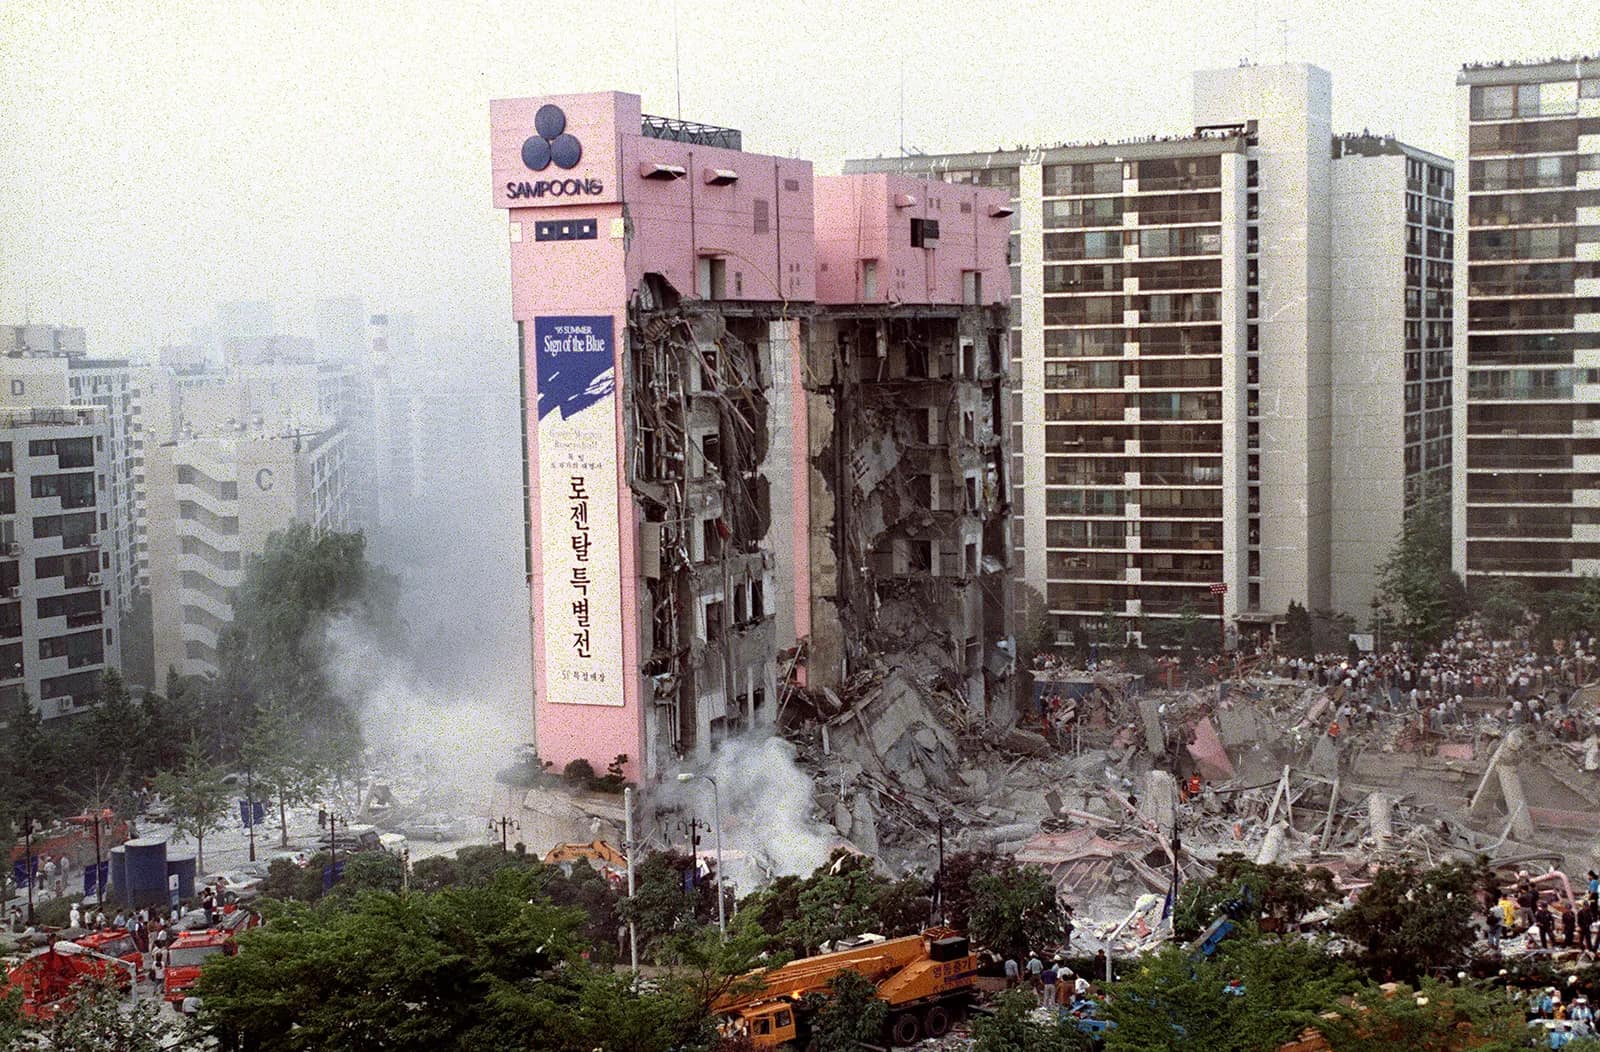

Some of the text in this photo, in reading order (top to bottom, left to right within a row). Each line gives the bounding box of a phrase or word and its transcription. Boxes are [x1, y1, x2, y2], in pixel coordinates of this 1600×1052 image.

[506, 178, 604, 199] SAMPOONG
[564, 325, 592, 335] SUMMER
[544, 335, 605, 357] Sign of the Blue
[11, 379, 25, 396] D
[255, 468, 274, 492] C
[569, 476, 592, 659] 로젠탈 특별전
